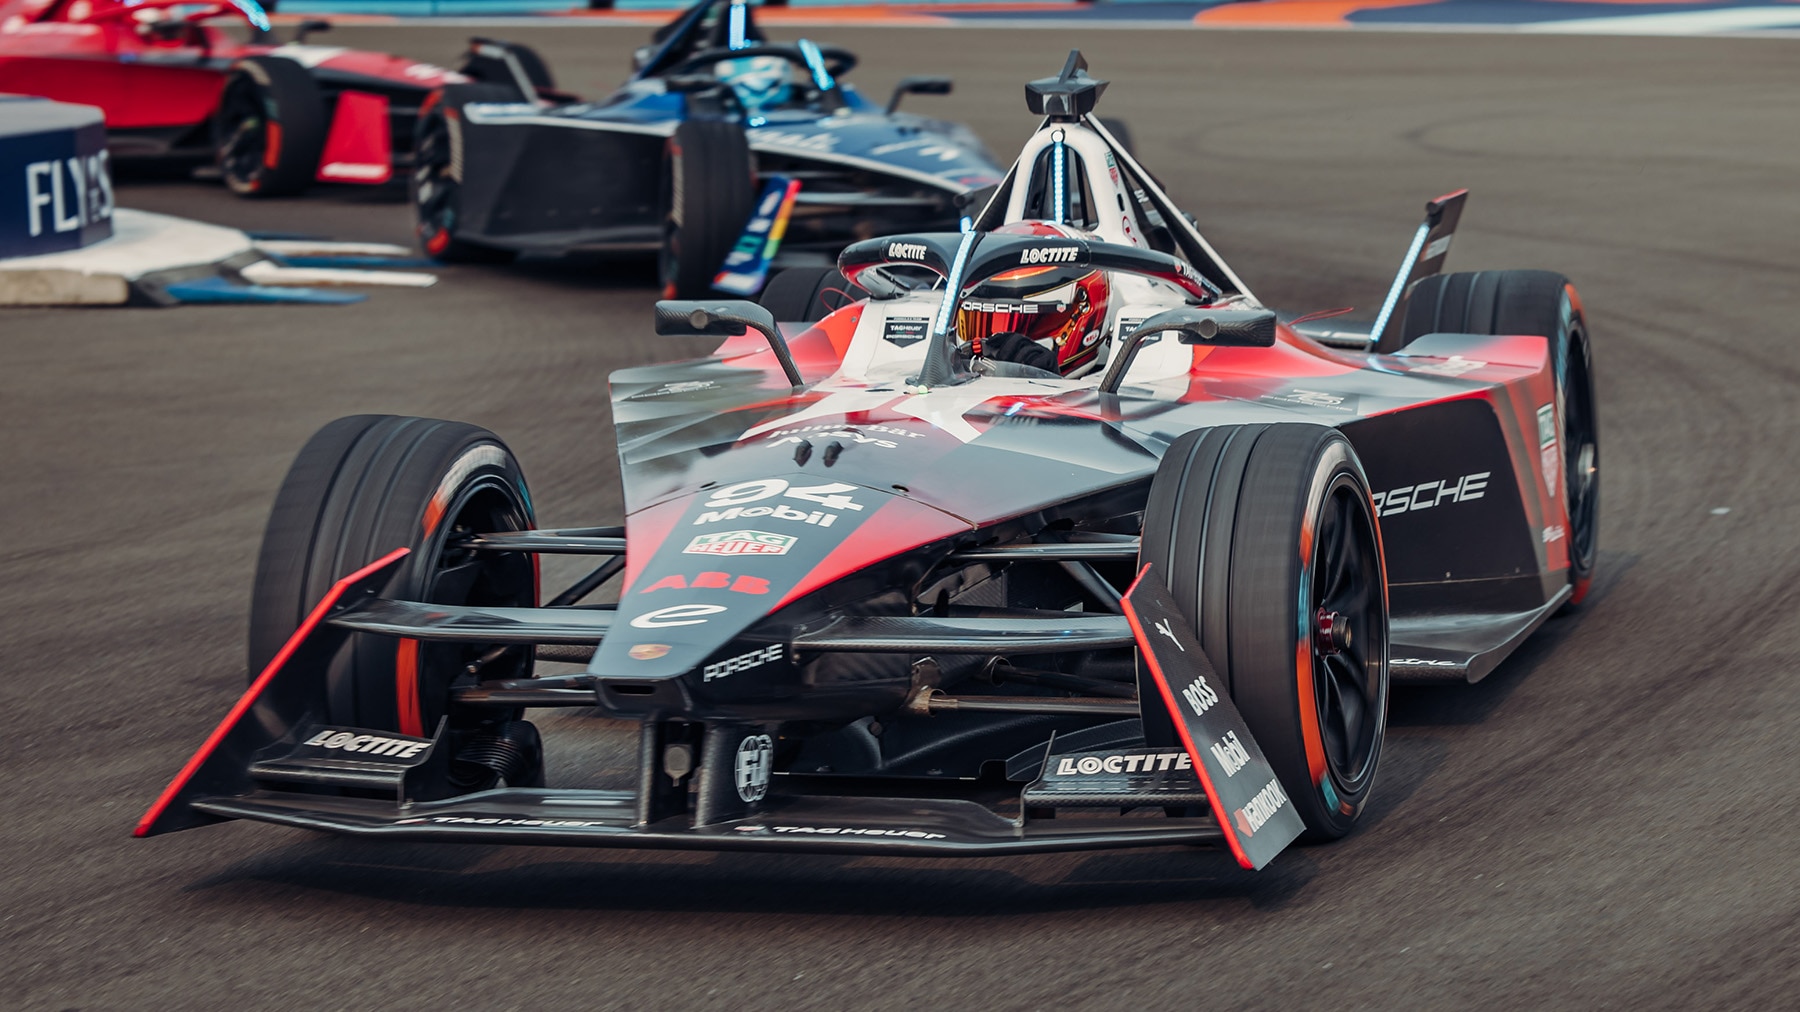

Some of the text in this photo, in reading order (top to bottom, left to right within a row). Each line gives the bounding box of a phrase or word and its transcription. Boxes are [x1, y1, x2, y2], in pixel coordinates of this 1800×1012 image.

[888, 242, 927, 260] LOCTITE
[1020, 247, 1079, 264] LOCTITE
[961, 301, 1039, 314] ORSCHE
[704, 479, 864, 511] 94
[1372, 471, 1491, 518] RSCHE
[693, 505, 838, 528] Mobil
[688, 541, 783, 554] HEUER
[698, 532, 787, 546] TAG
[640, 571, 771, 595] ABB
[703, 643, 783, 682] PORSCHE
[1182, 675, 1219, 717] BOSS
[303, 730, 432, 758] LOCTITE
[1210, 730, 1251, 778] Mobil
[1056, 753, 1193, 776] LOCTITE
